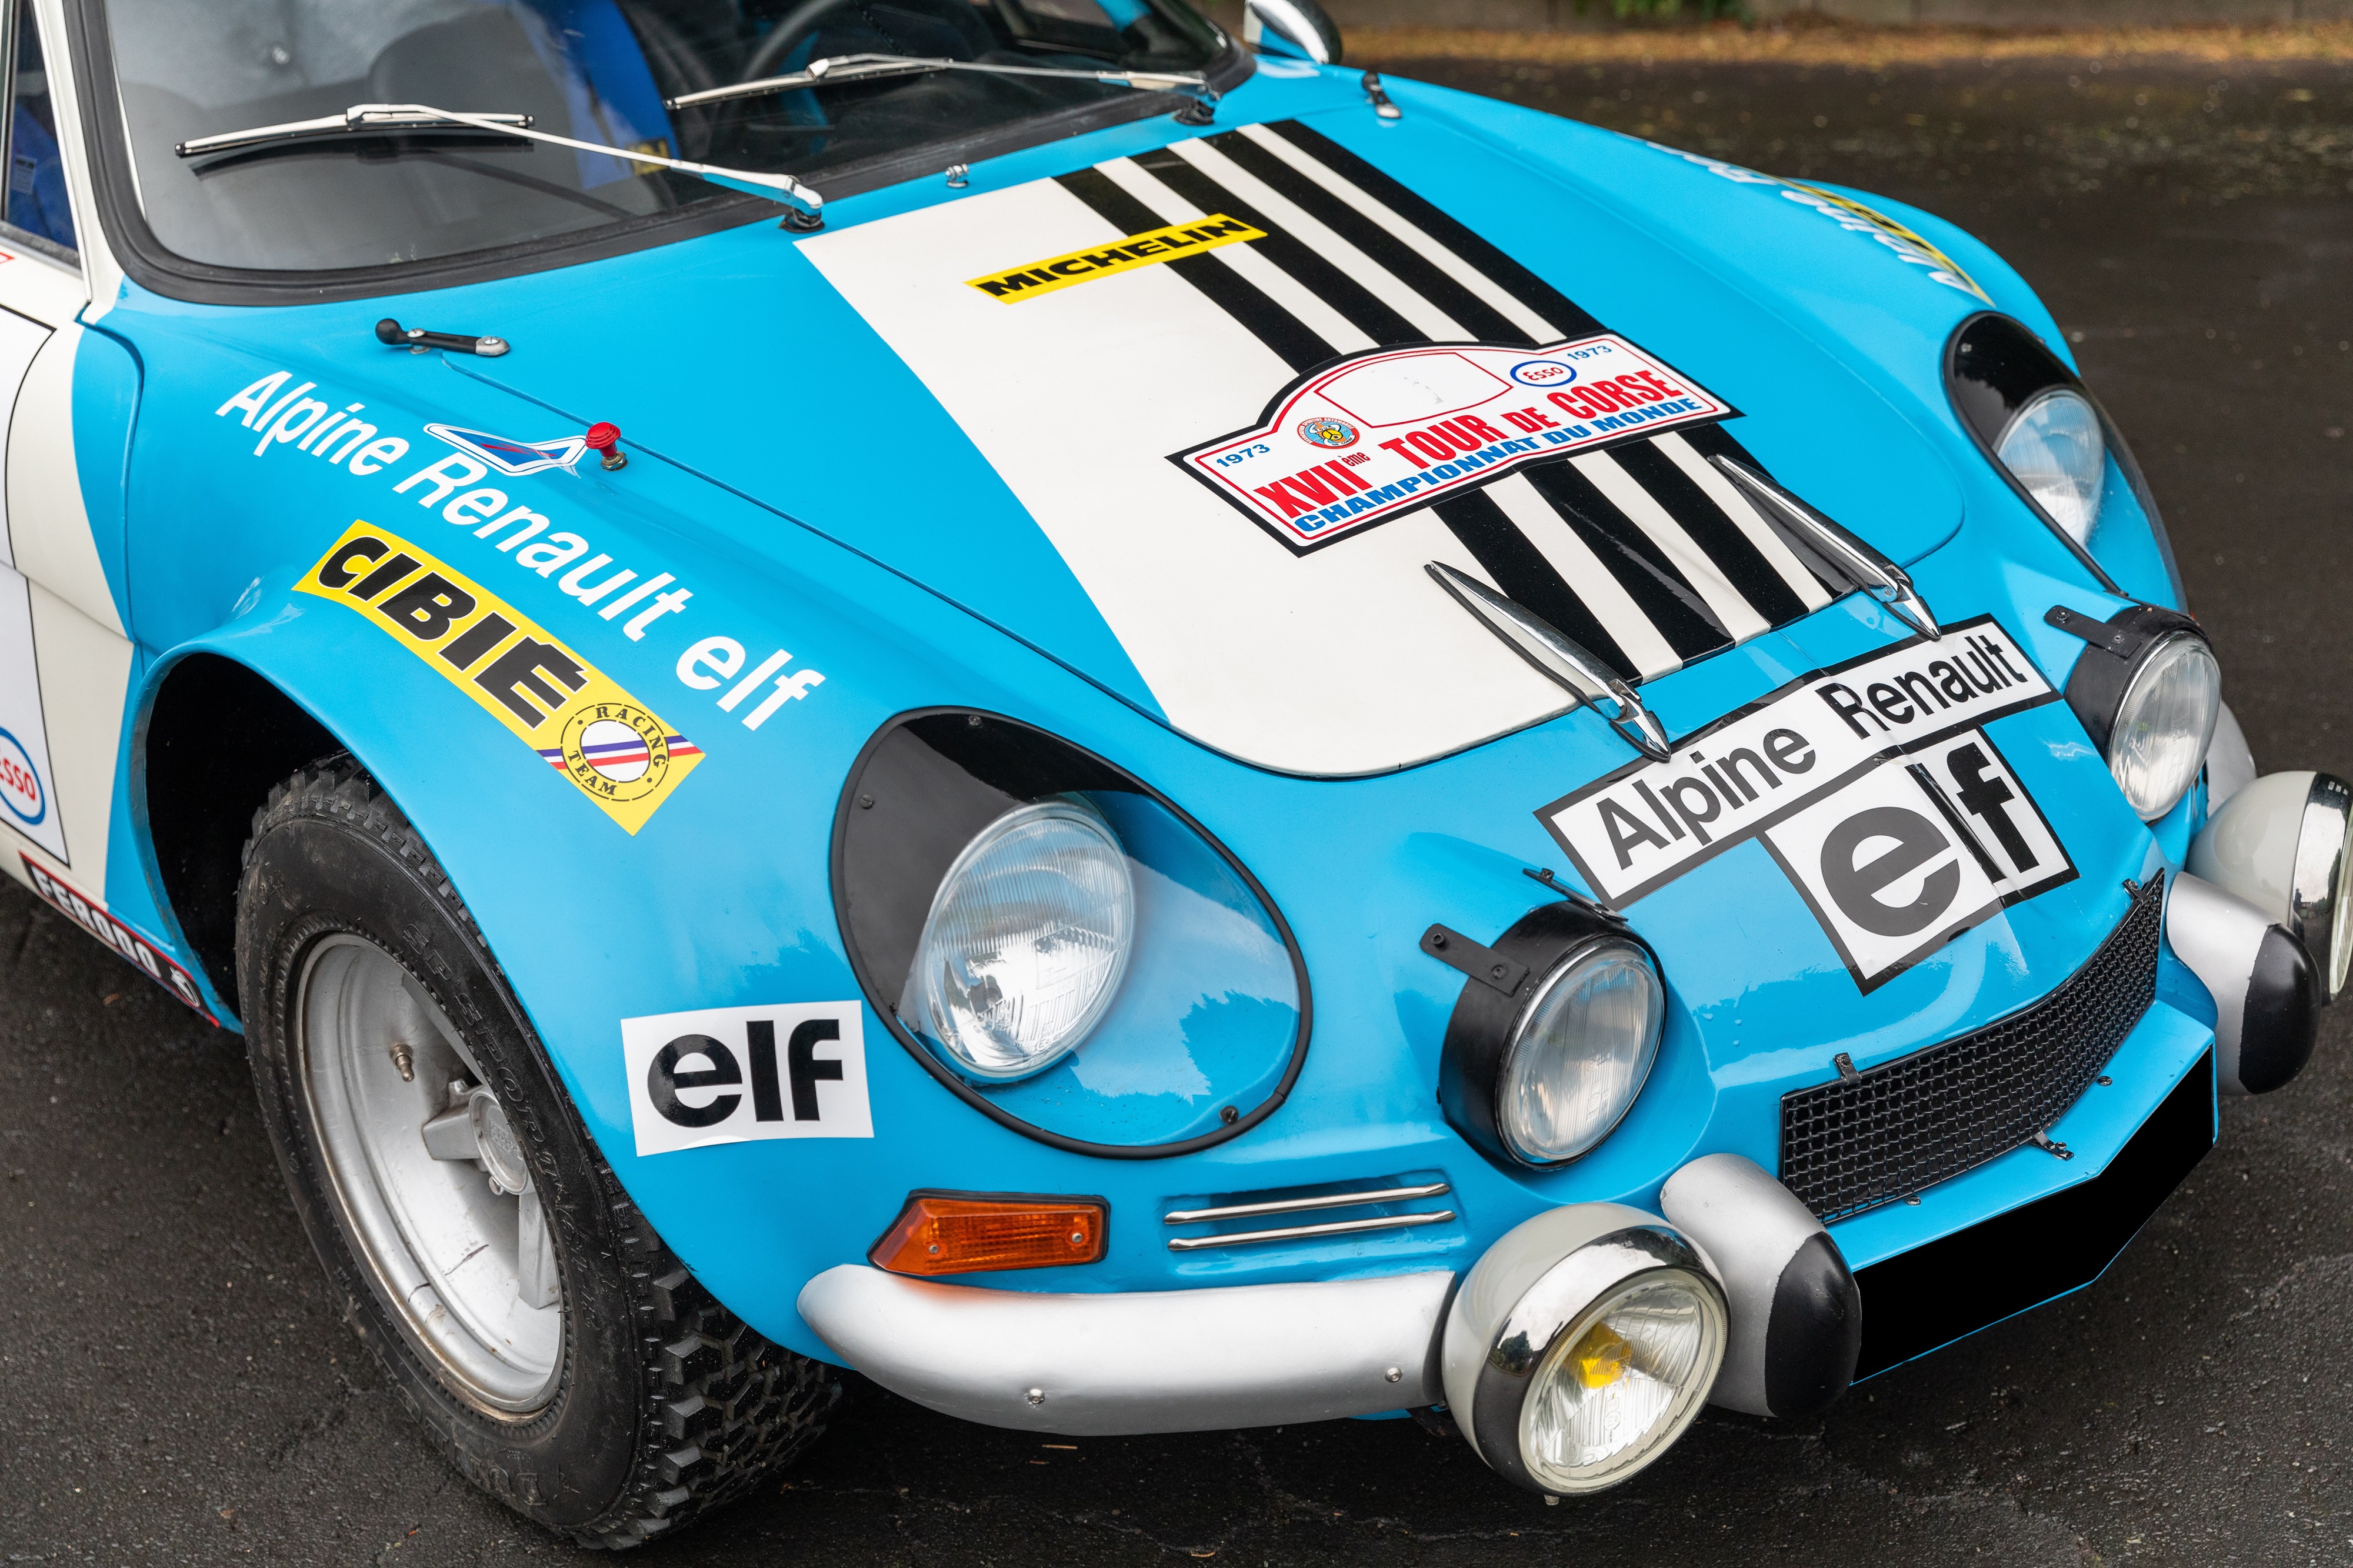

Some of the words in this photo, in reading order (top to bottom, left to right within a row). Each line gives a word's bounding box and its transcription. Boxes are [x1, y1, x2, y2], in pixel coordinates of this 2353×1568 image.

[976, 220, 1251, 297] MICHELIN
[1567, 345, 1612, 361] 1973
[1216, 443, 1271, 467] 1973
[1294, 437, 1542, 532] CHAMPIONNAT
[1541, 425, 1592, 445] DU
[1594, 398, 1702, 431] MONDE
[1377, 415, 1509, 469] TOUR
[1500, 407, 1561, 433] DE
[1547, 370, 1685, 419] CORSE
[215, 371, 409, 475] Alpine
[392, 452, 694, 642] Renault
[676, 636, 826, 731] elf
[0, 758, 36, 802] sso
[568, 750, 617, 796] TEAM
[595, 706, 666, 768] RACING
[1595, 728, 1817, 871] Alpine
[1815, 635, 2028, 740] Renault
[1820, 742, 2040, 938] elf
[30, 865, 162, 979] FERODO
[647, 1019, 844, 1129] elf
